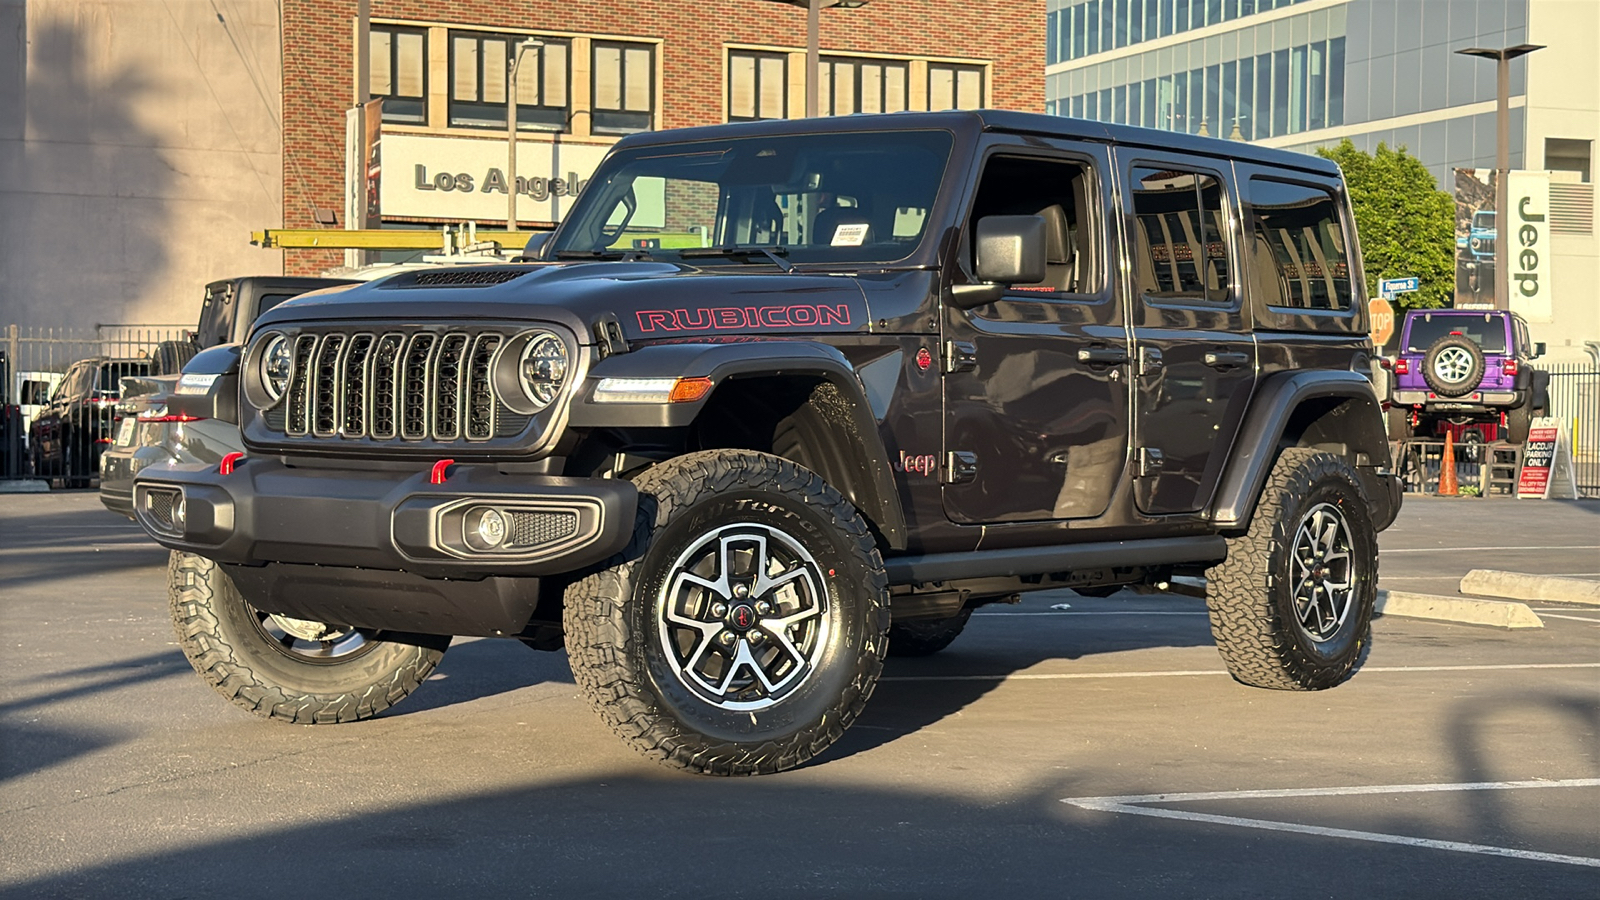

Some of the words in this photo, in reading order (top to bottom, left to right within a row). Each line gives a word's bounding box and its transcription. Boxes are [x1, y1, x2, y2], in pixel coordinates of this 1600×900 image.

[414, 164, 474, 192] Los
[480, 167, 588, 201] Angel
[1514, 196, 1545, 297] Jeep
[635, 304, 851, 332] RUBICON
[1371, 312, 1391, 331] TOP
[1526, 450, 1552, 458] PARKING
[1527, 442, 1554, 450] LACDJR
[894, 450, 936, 476] Jeep
[1527, 458, 1547, 467] ONLY
